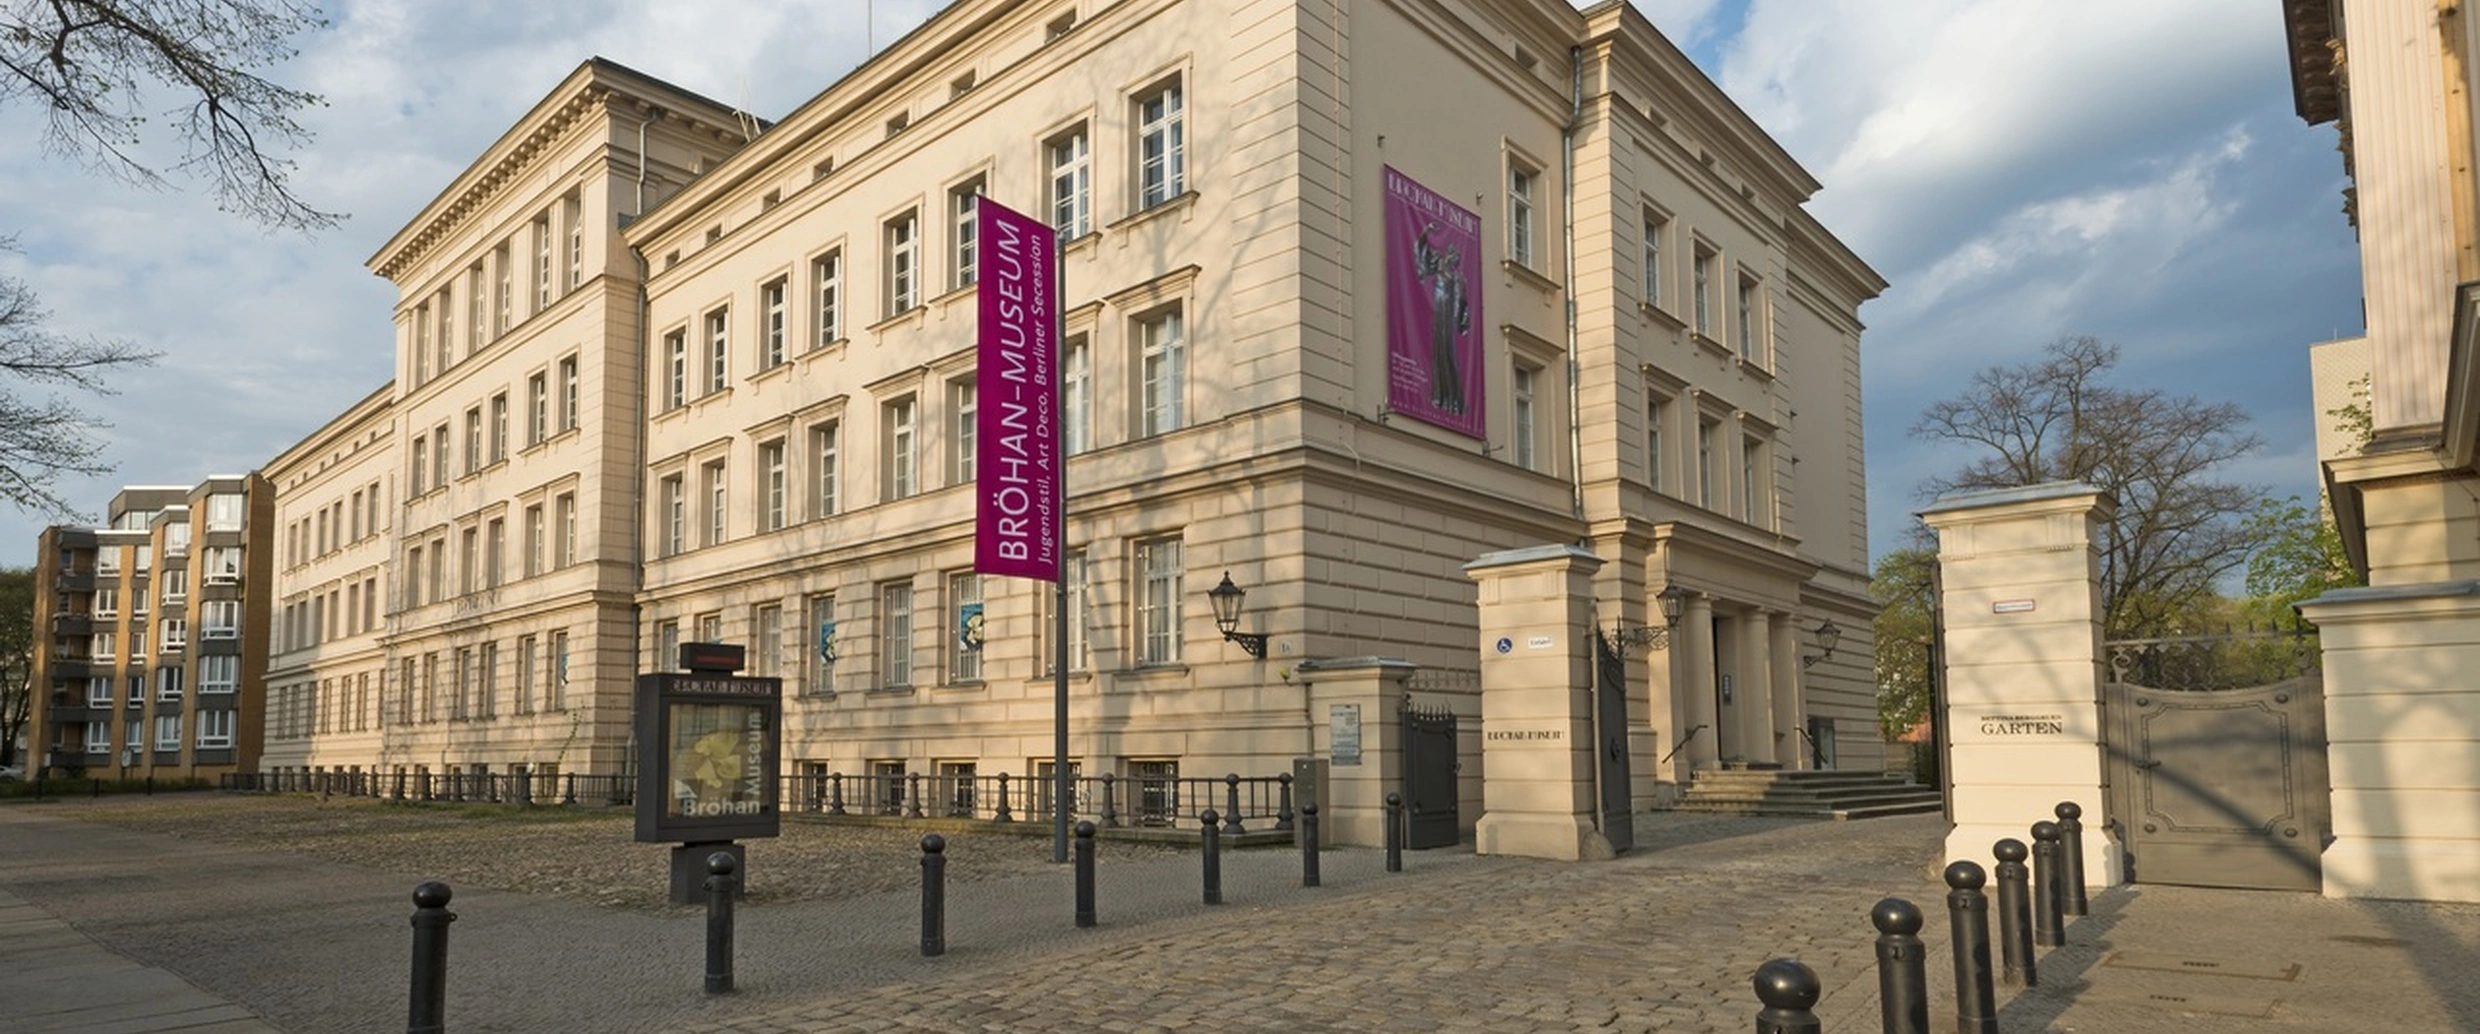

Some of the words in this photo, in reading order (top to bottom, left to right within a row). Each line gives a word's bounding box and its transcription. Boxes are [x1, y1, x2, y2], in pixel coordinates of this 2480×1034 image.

[1029, 234, 1045, 317] Secession
[1032, 319, 1047, 385] Berliner
[1035, 391, 1050, 438] Deco,
[1036, 443, 1050, 471] Art
[1037, 476, 1054, 564] Jugendstil,
[744, 712, 762, 795] Museum
[1981, 721, 2062, 736] GARTEN
[683, 797, 760, 816] Bröhan
